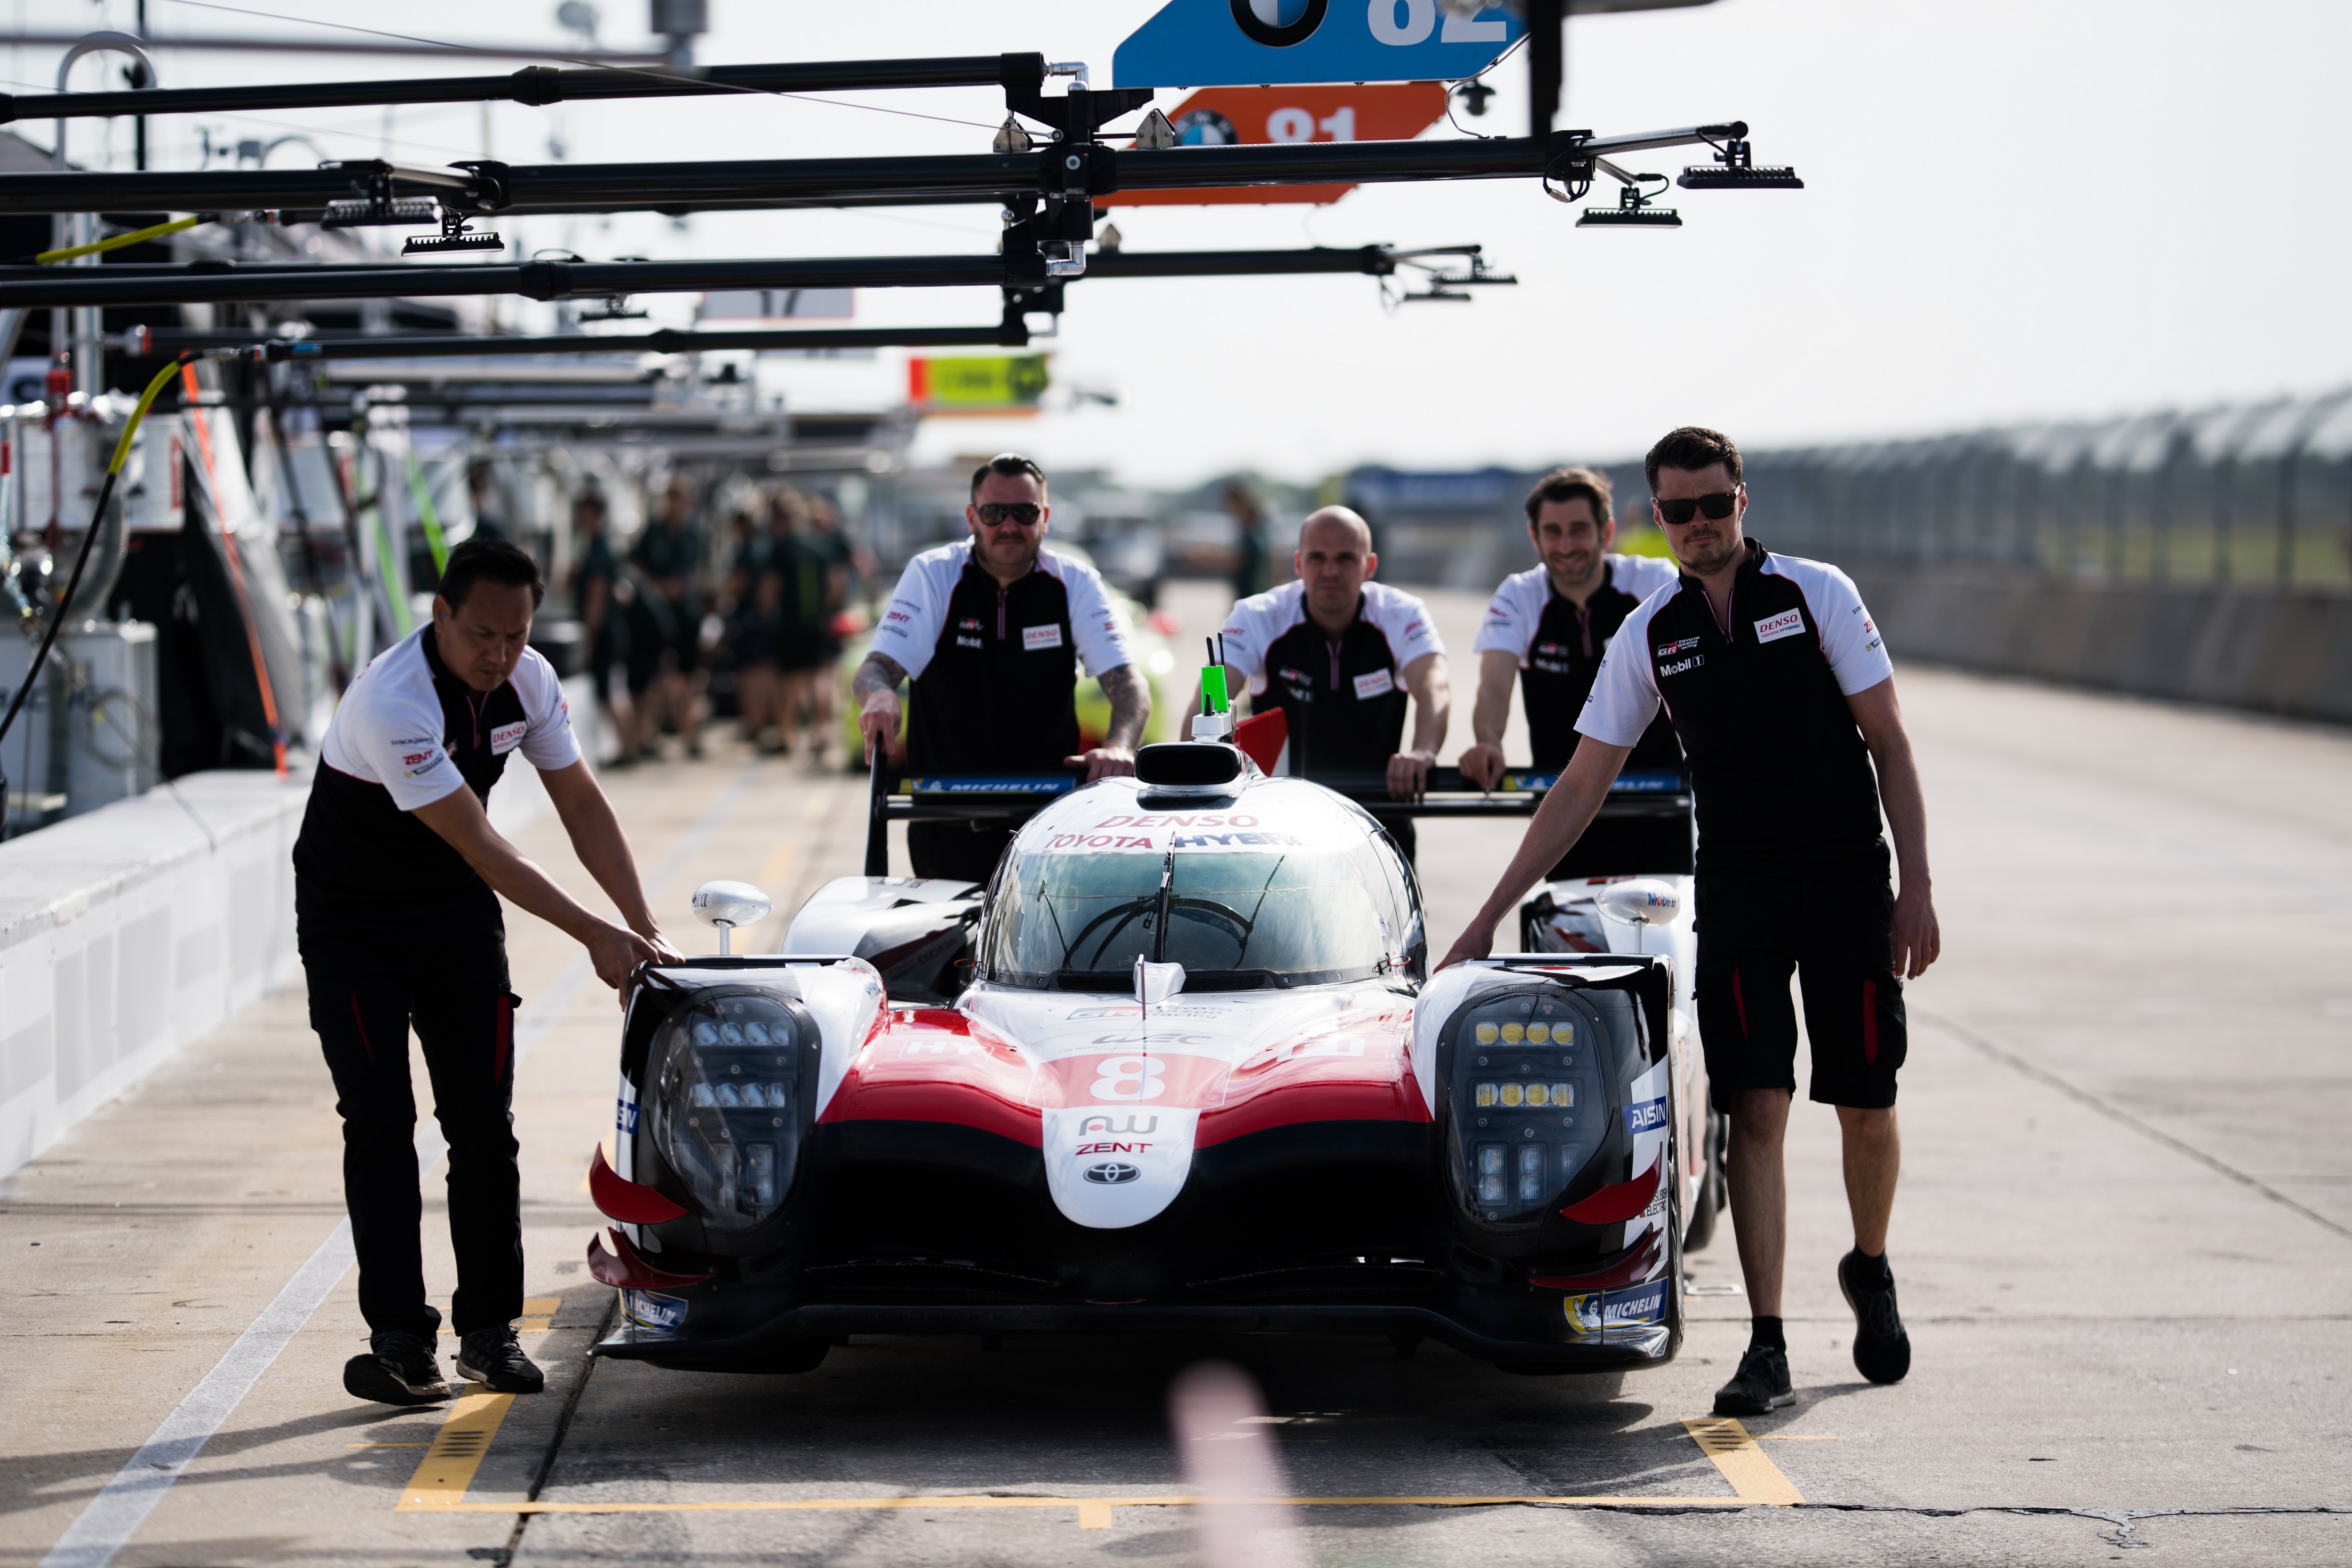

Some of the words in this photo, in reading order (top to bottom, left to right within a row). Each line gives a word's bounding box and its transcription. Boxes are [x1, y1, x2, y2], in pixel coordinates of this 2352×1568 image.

[1760, 614, 1797, 633] DENSO
[1780, 624, 1800, 633] HYBRID
[1659, 646, 1676, 656] GR
[1660, 658, 1692, 677] Mobil
[493, 726, 525, 743] DENSO
[402, 749, 433, 765] ZENT
[1093, 816, 1259, 828] DENSO
[1044, 833, 1153, 849] TOYOTA
[1648, 892, 1670, 908] Mobil
[1090, 1056, 1165, 1101] 8
[1631, 1102, 1666, 1129] AISIN
[1075, 1142, 1153, 1156] ZENT
[1604, 1293, 1662, 1320] MICHELIN
